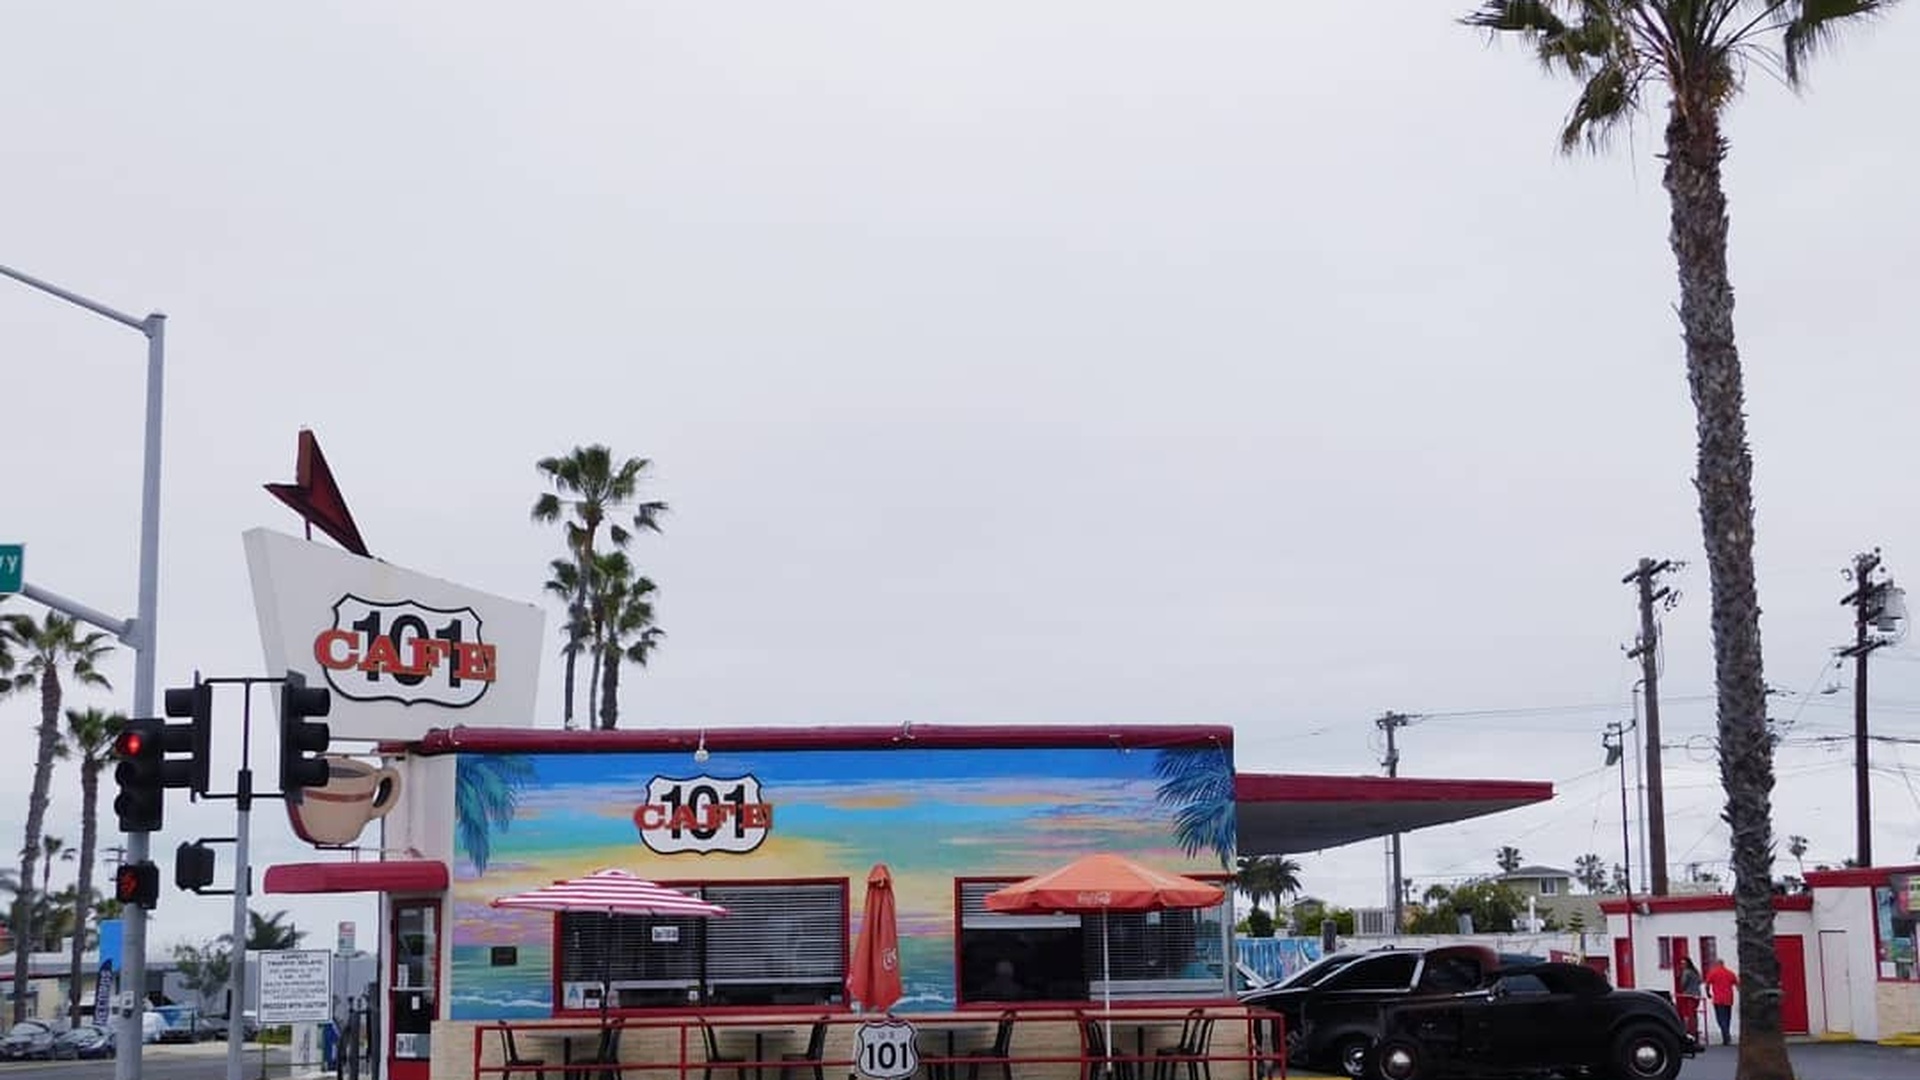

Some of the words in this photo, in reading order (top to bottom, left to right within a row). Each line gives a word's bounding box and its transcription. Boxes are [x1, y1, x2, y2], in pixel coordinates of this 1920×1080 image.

[314, 629, 496, 682] CAFE
[353, 611, 462, 688] 101
[634, 803, 773, 831] CAFE
[661, 784, 745, 839] 101
[866, 1042, 907, 1069] 101
